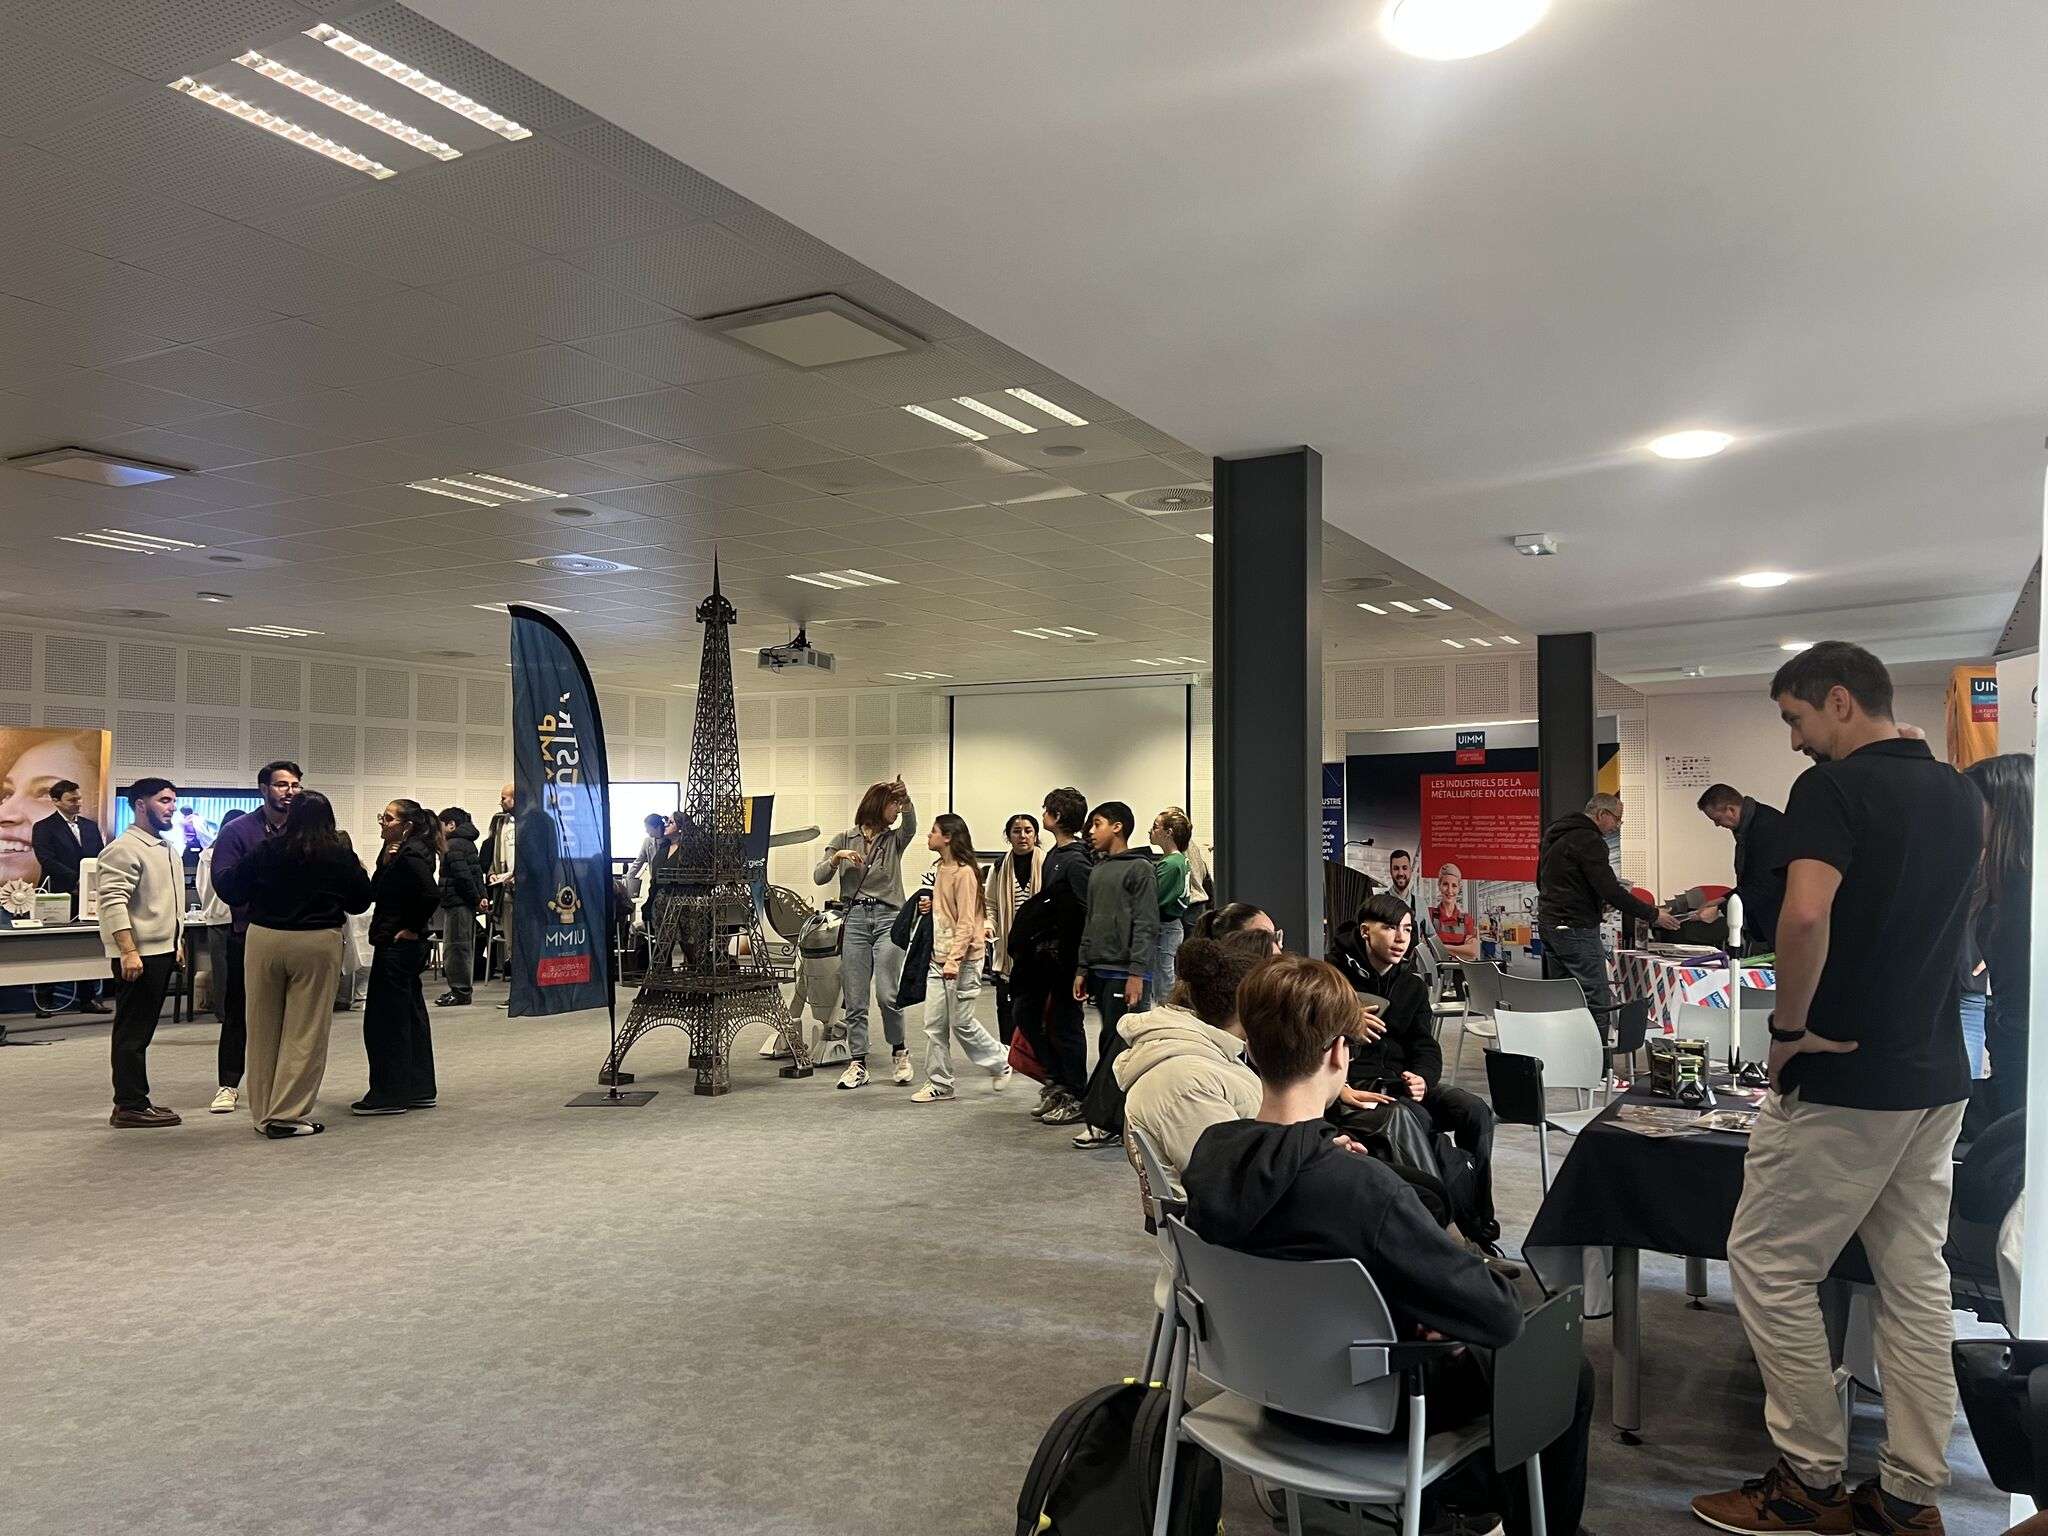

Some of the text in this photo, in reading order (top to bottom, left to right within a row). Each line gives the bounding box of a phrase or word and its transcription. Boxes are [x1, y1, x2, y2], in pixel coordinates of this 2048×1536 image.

[1975, 681, 1998, 692] UIM
[1458, 734, 1483, 744] UIMM
[1431, 778, 1521, 788] LES INDUSTRIELS DE LA
[1485, 790, 1497, 798] EN
